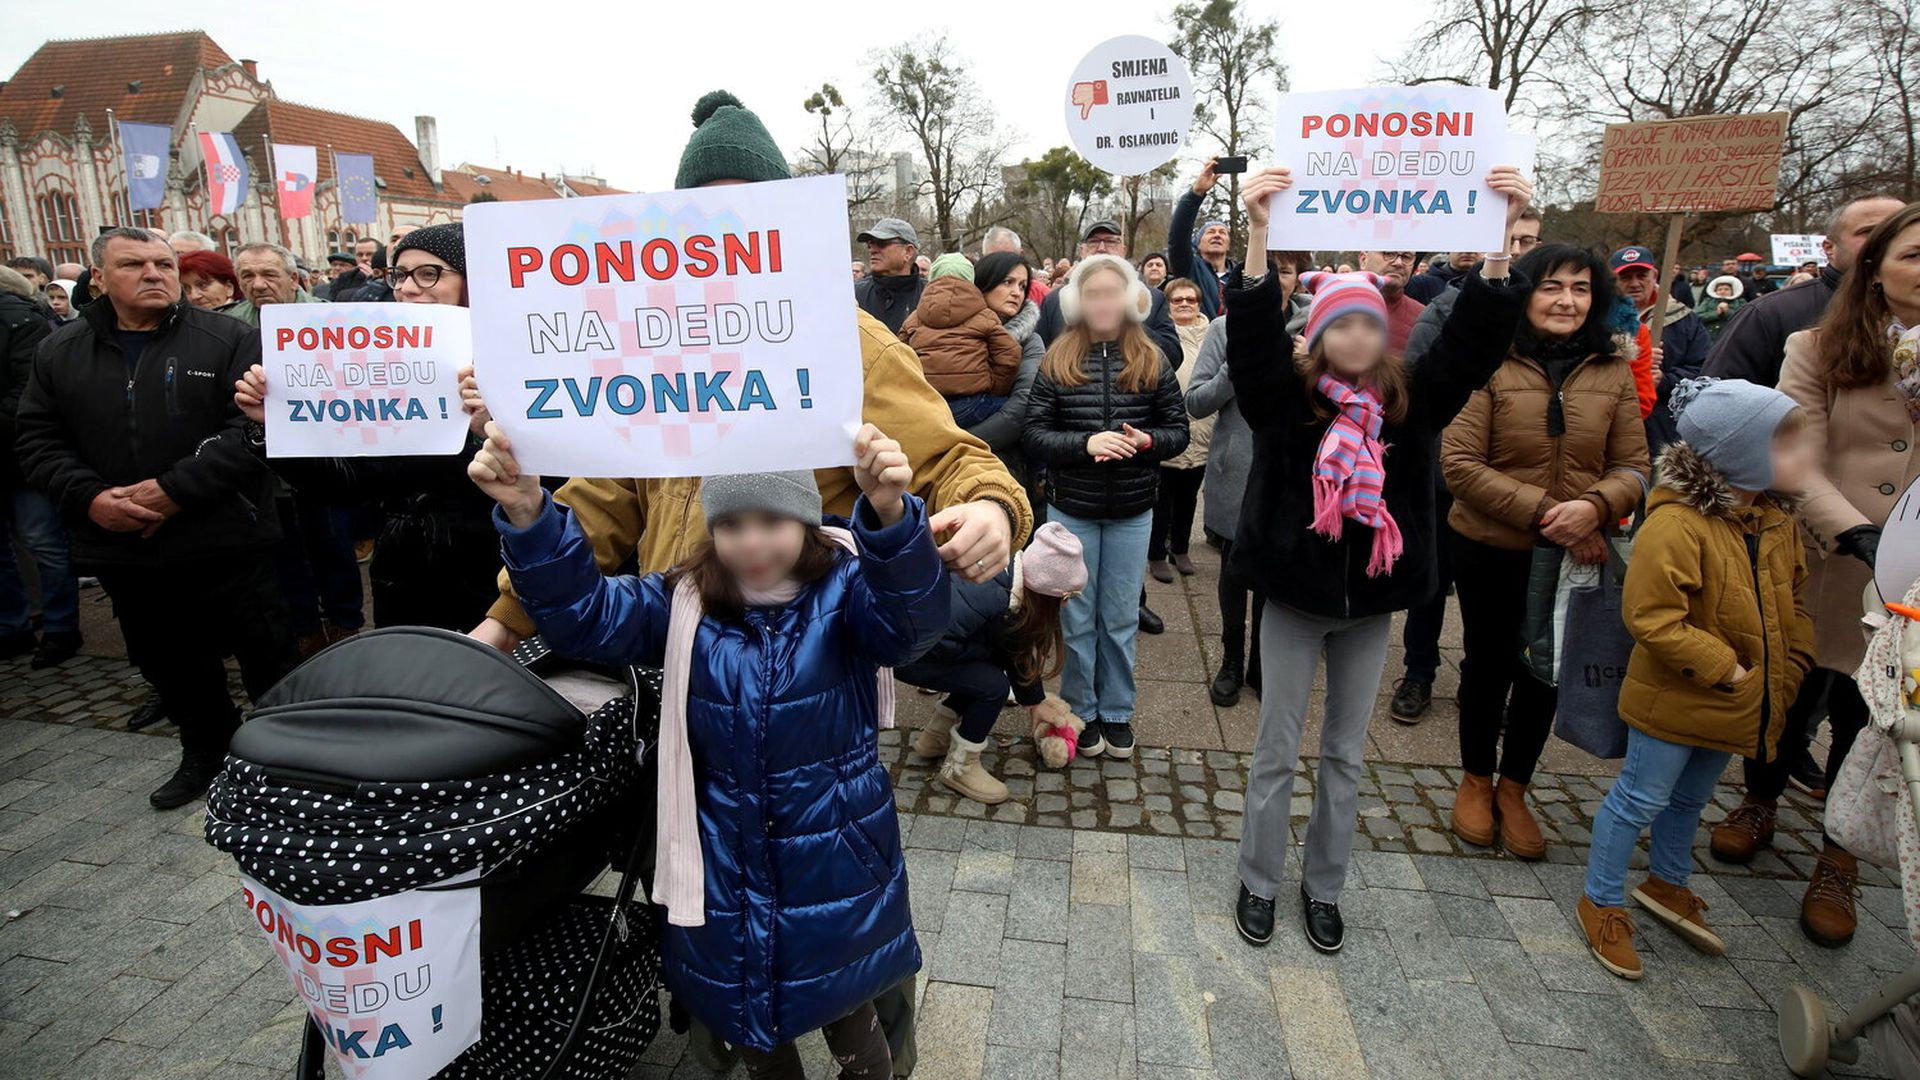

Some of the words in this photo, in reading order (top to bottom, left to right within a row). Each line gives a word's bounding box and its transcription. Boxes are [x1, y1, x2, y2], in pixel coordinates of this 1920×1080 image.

[1112, 58, 1168, 79] SMJENA
[1117, 87, 1180, 105] RAVNATELJA
[1150, 108, 1154, 120] I
[1301, 112, 1473, 138] PONOSNI
[1096, 136, 1114, 149] DR.
[1119, 130, 1178, 148] OSLAKOVIĆ
[1608, 126, 1669, 146] DVOJE
[1717, 117, 1780, 139] KIRURGA
[1307, 152, 1357, 176] NA
[1372, 151, 1475, 176] DEDU
[1665, 149, 1674, 164] U
[1295, 190, 1452, 214] ZVONKA
[1467, 190, 1477, 214] !
[507, 229, 783, 289] PONOSNI
[276, 326, 433, 351] PONOSNI
[527, 311, 615, 354] NA
[635, 300, 794, 349] DEDU
[285, 364, 333, 387] NA
[343, 361, 436, 386] DEDU
[524, 370, 777, 419] ZVONKA
[796, 368, 813, 409] !
[287, 397, 428, 422] ZVONKA
[438, 397, 449, 420] !
[298, 964, 432, 1014] DEDU
[431, 1004, 443, 1034] !
